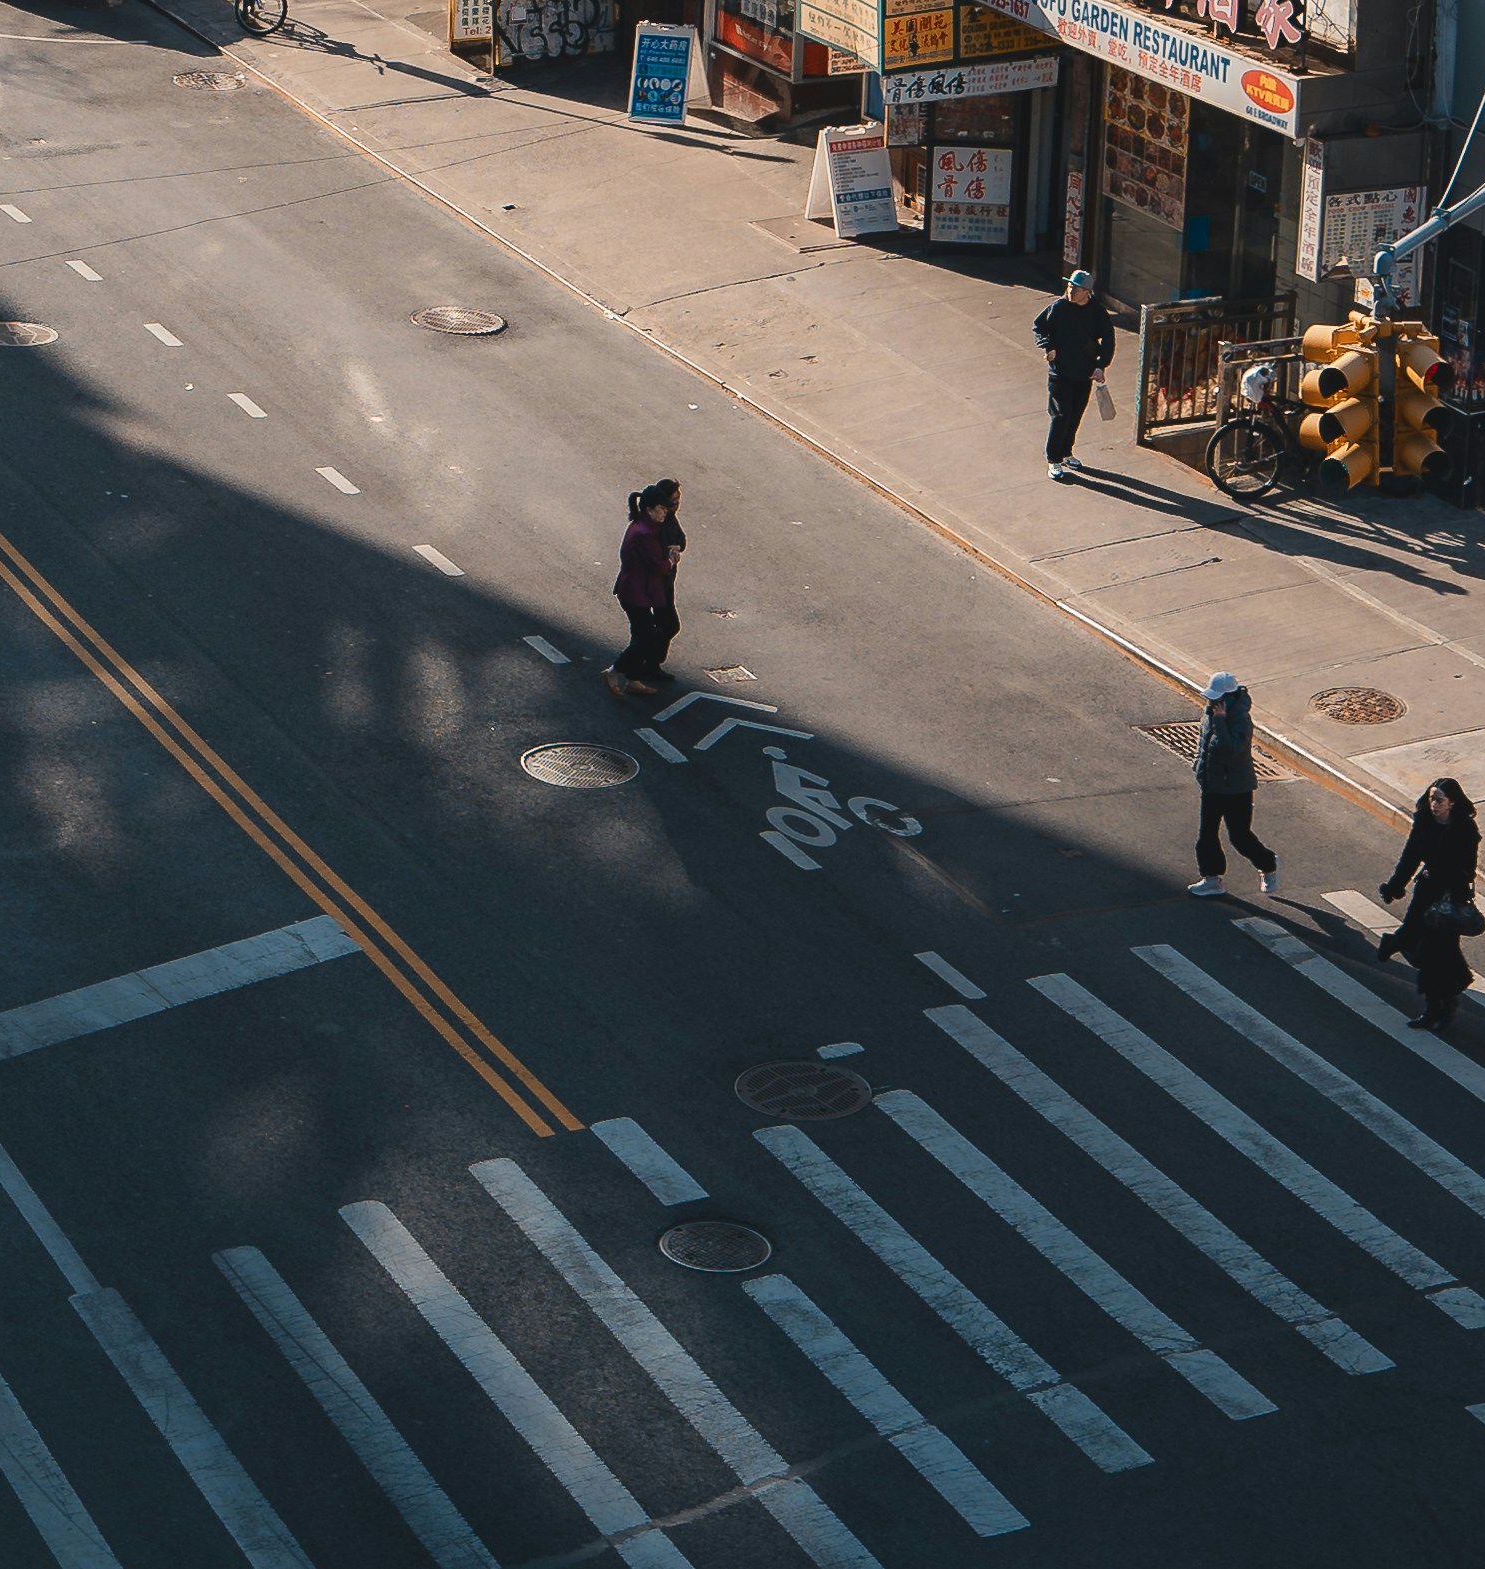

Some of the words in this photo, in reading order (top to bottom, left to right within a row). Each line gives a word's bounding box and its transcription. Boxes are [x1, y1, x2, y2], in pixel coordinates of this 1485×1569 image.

[889, 31, 948, 53] 文化流協會
[1133, 17, 1231, 84] RESTAURANT
[1328, 190, 1398, 208] 各式點心
